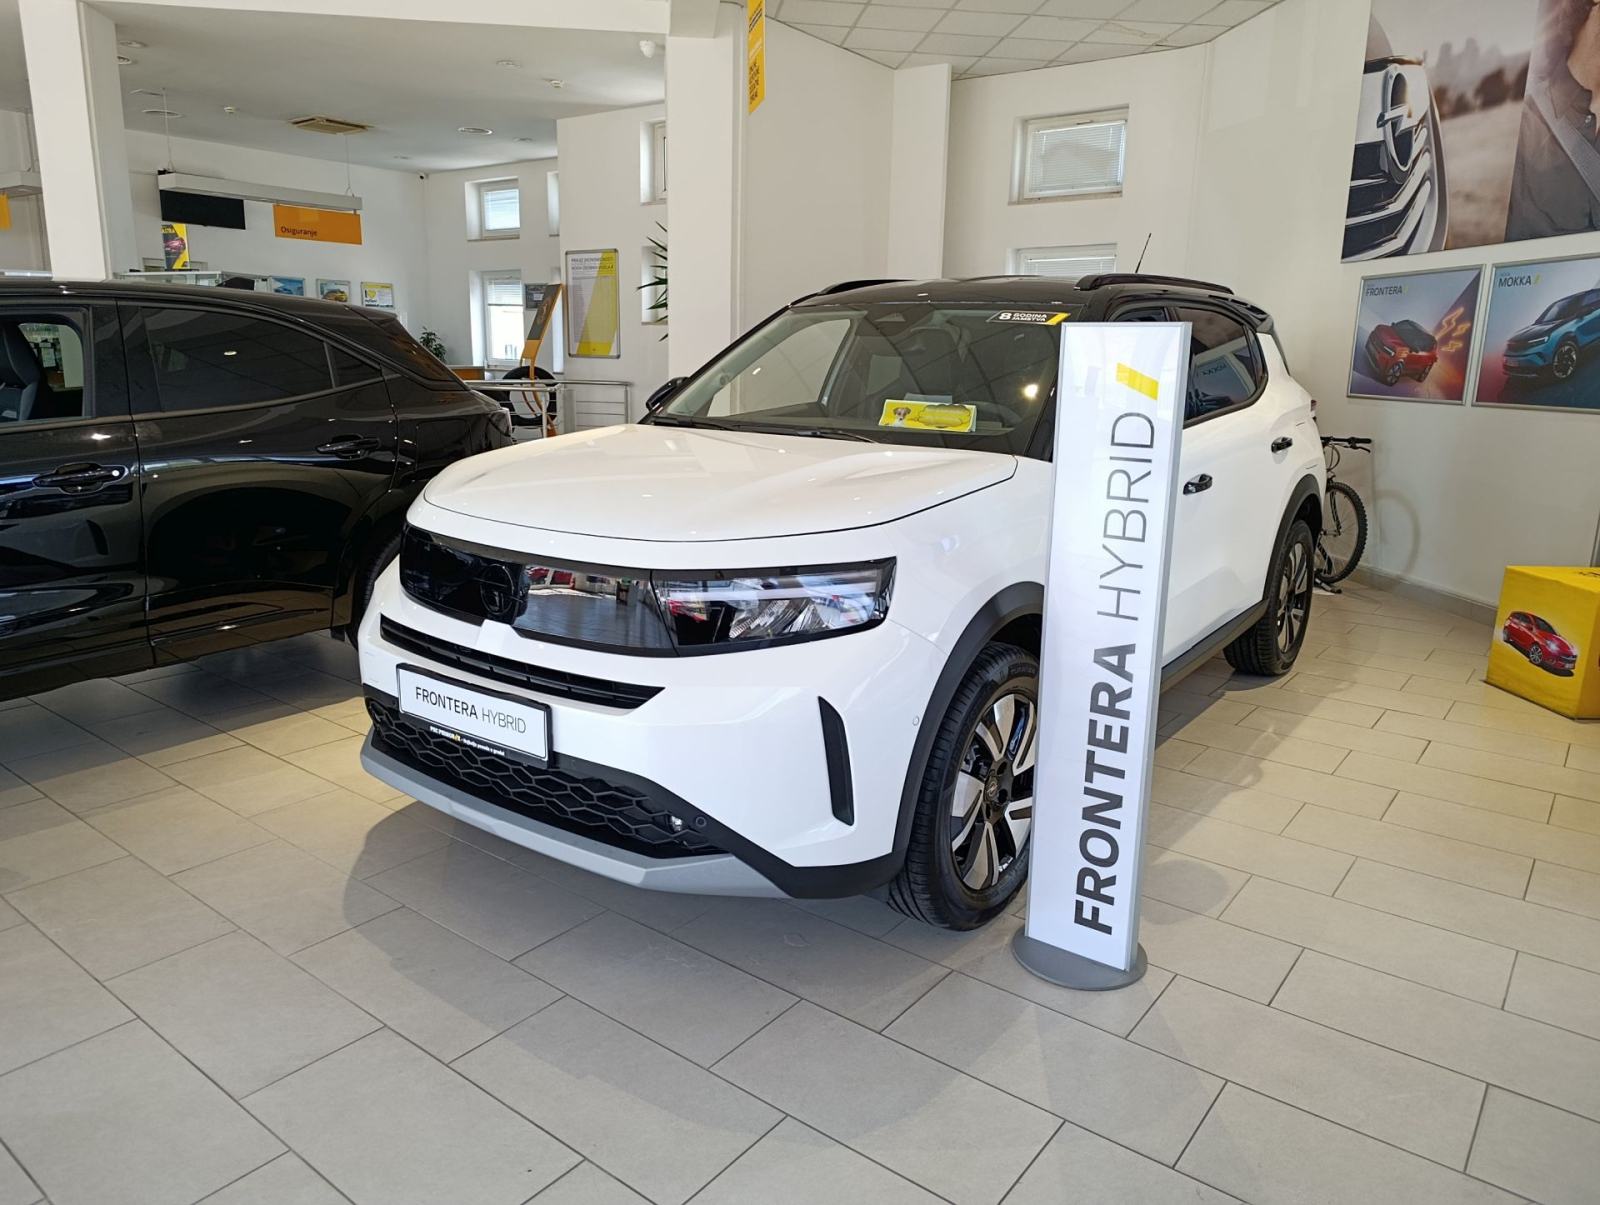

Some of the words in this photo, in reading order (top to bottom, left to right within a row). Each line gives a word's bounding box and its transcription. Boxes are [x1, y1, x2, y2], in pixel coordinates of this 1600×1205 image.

[281, 226, 317, 237] Osiguranje
[1499, 276, 1531, 287] MOKKA
[1366, 285, 1402, 297] FRONTERA
[999, 312, 1012, 320] 8
[1097, 412, 1155, 621] HYBRID
[415, 686, 478, 719] FRONTERA
[482, 707, 527, 734] HYBRID
[1074, 643, 1136, 935] FRONTERA
